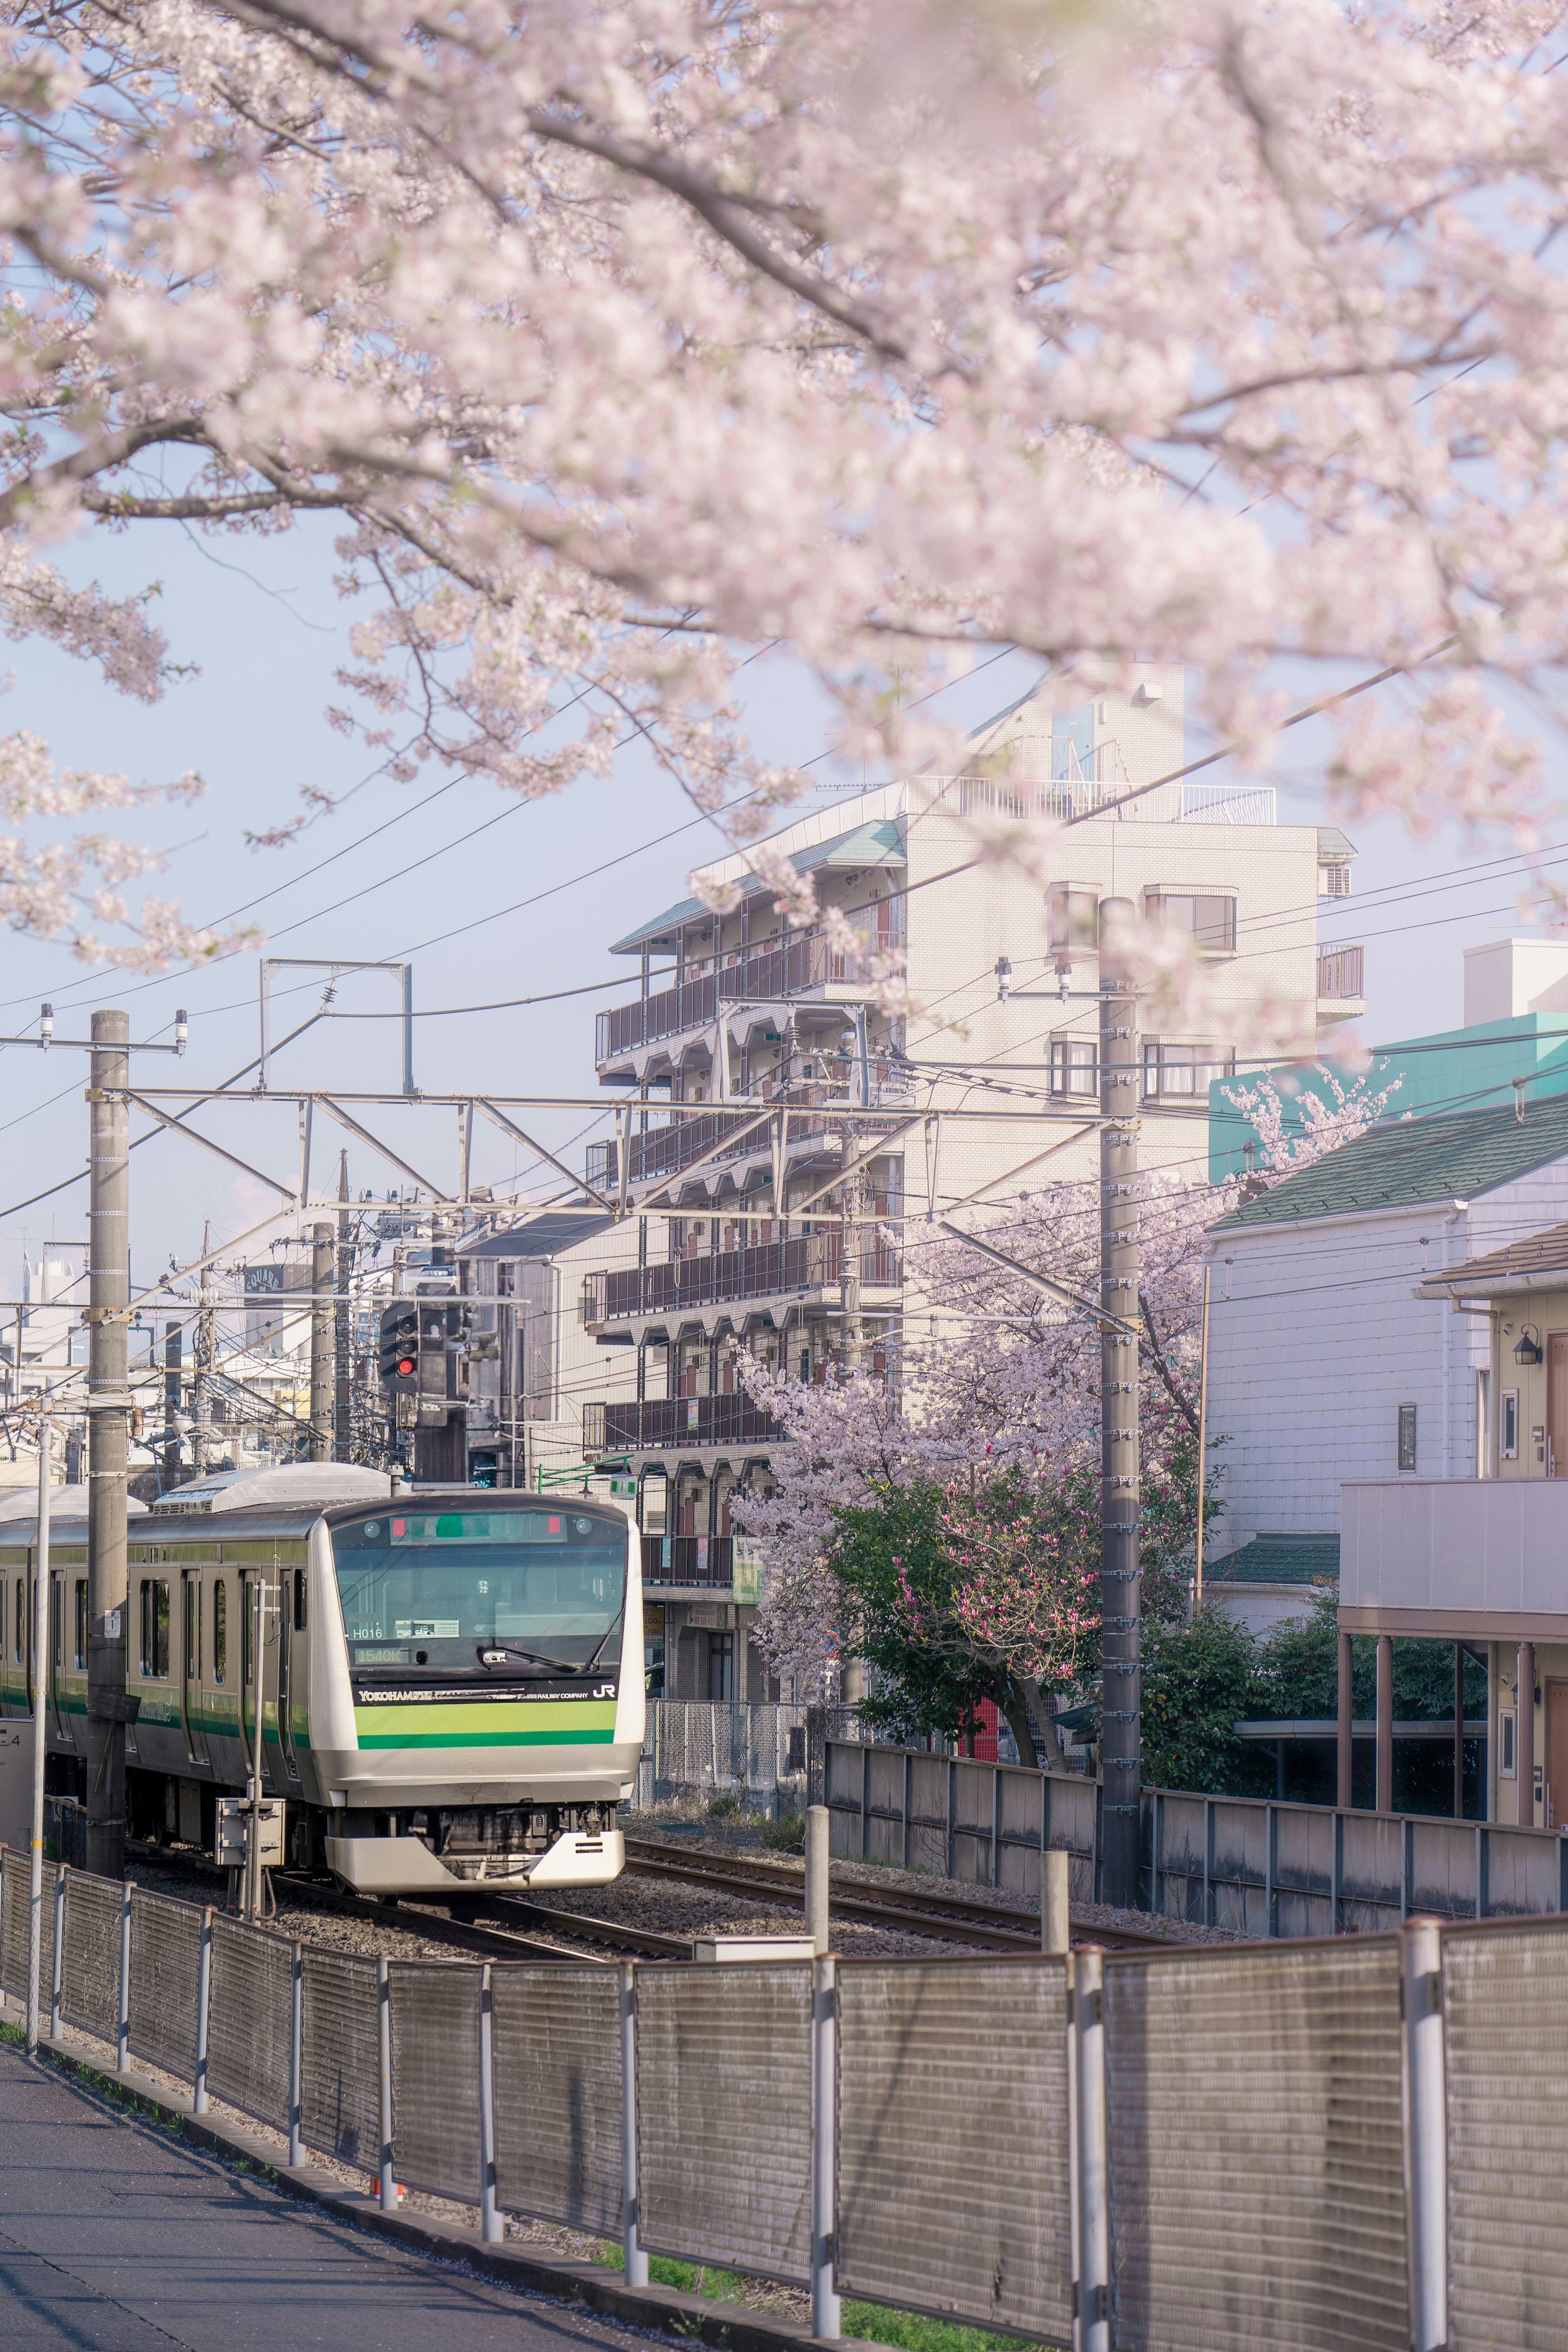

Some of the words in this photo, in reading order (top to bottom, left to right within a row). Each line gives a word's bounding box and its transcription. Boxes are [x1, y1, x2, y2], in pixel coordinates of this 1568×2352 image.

[354, 1629, 382, 1638] H016
[360, 1650, 401, 1662] 1540K
[593, 1684, 615, 1698] JR
[12, 1735, 20, 1746] 4
